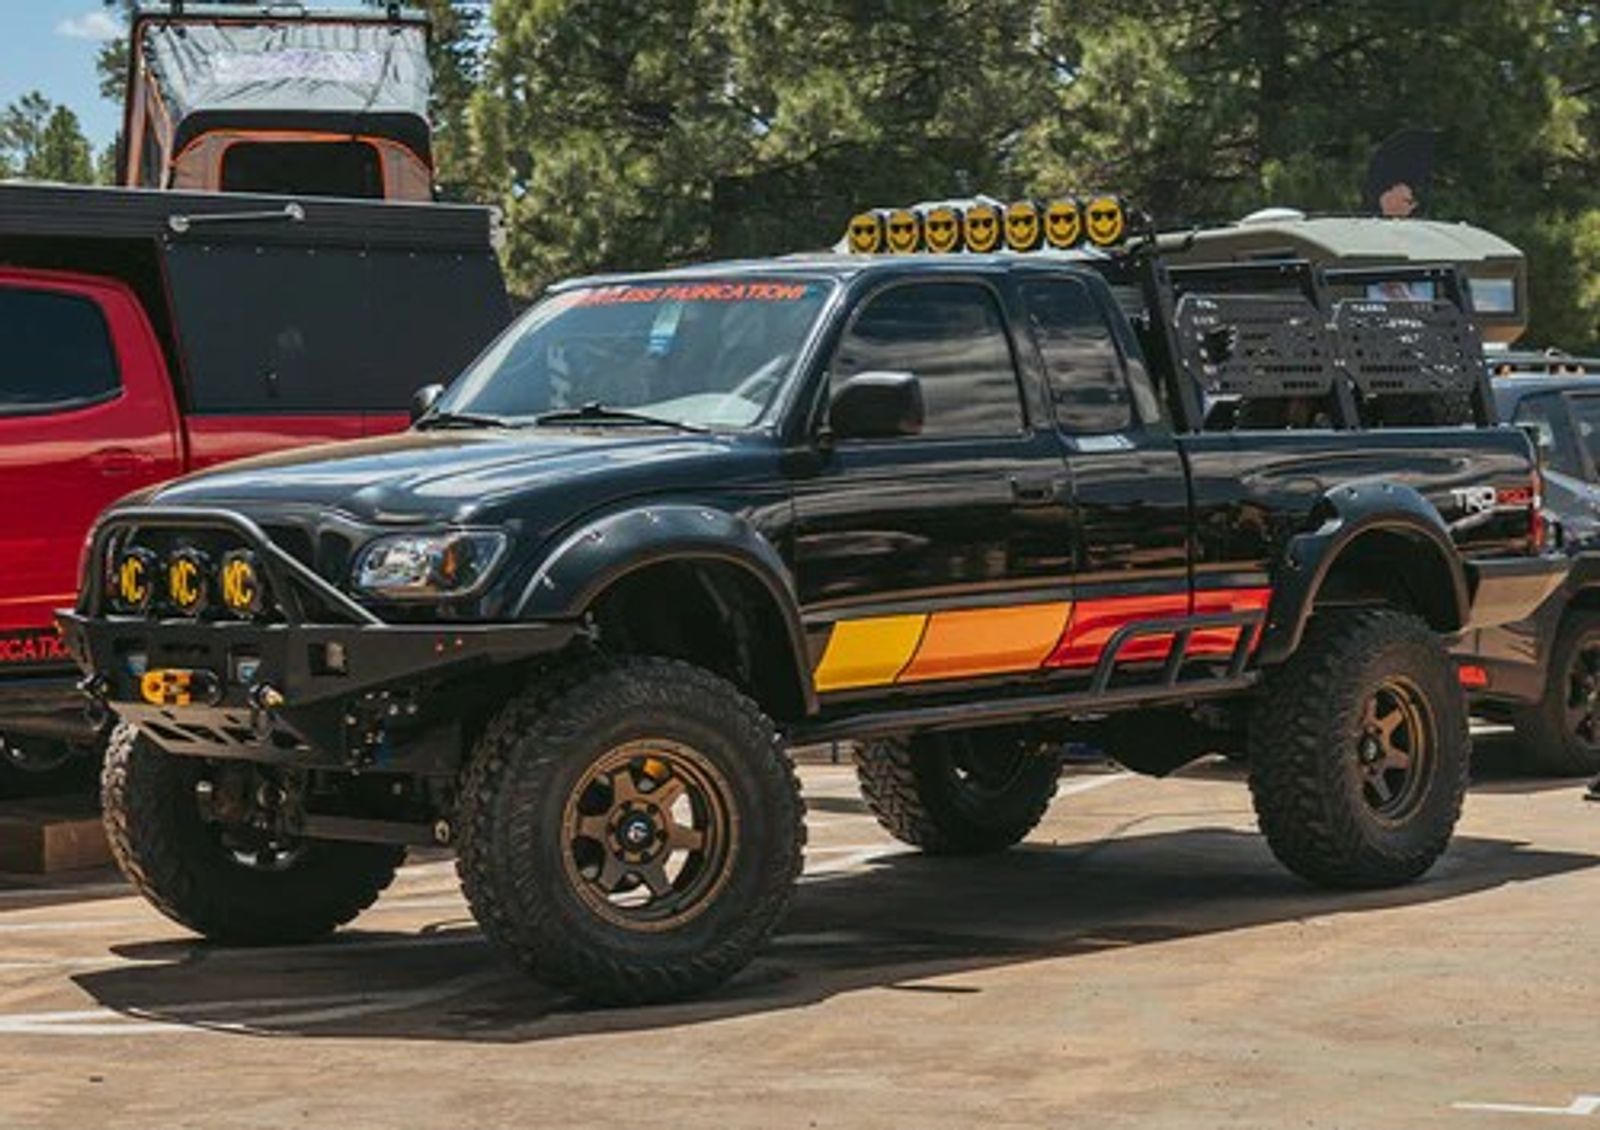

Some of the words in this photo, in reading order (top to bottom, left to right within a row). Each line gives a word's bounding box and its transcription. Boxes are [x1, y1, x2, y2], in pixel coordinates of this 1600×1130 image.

[120, 557, 144, 603] KC
[169, 560, 197, 605] KC
[223, 561, 252, 606] KC
